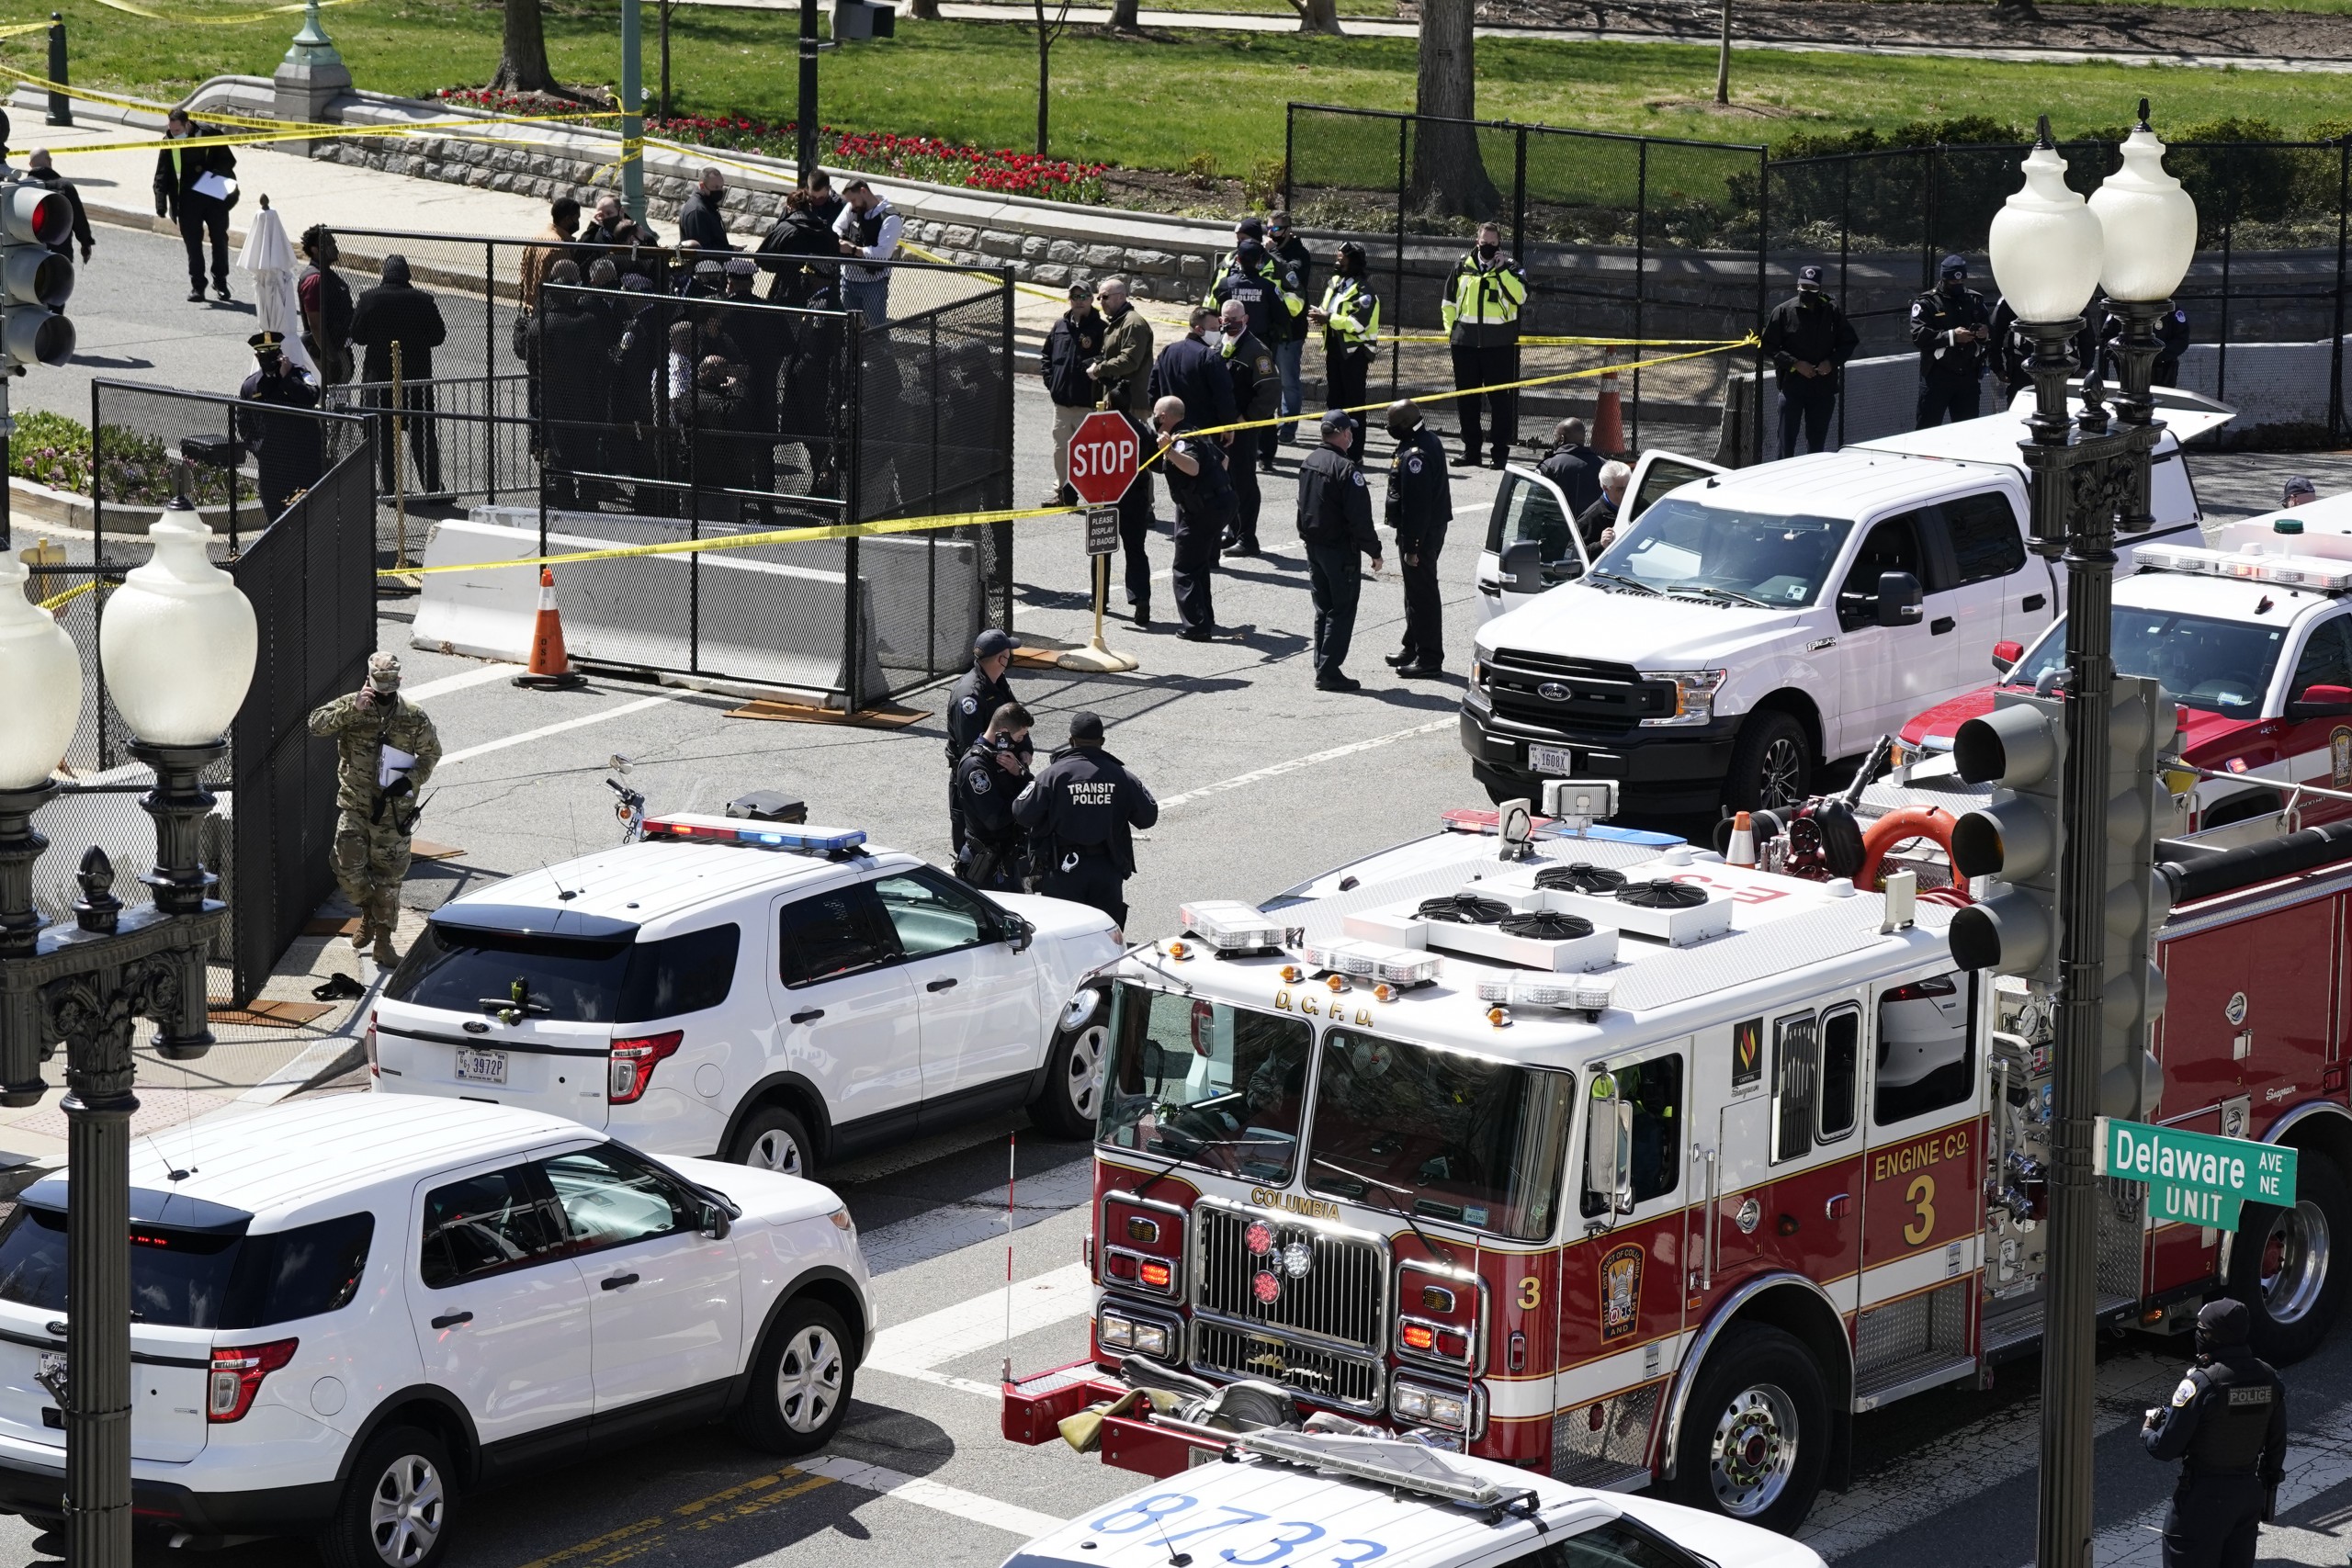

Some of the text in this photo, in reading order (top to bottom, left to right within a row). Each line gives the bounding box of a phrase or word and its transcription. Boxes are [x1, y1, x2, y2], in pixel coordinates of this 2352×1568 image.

[1073, 440, 1134, 478] STOP
[1091, 515, 1114, 525] PLEASE
[1091, 526, 1114, 536] DISPLAY
[1090, 536, 1116, 547] ID BADGE
[1544, 687, 1563, 698] Ford
[1542, 753, 1566, 769] 1608X
[1068, 783, 1115, 794] TRANSIT
[1072, 794, 1112, 805] POLICE
[1274, 989, 1374, 1027] D. C. F. D.
[473, 1057, 503, 1076] 3972P
[2236, 1076, 2242, 1086] 3
[1875, 1139, 1939, 1181] ENGINE
[2116, 1129, 2283, 1189] Delaware AVE
[2259, 1175, 2279, 1196] NE
[1251, 1187, 1340, 1223] COLUMBIA
[1904, 1174, 1936, 1247] 3
[2165, 1186, 2222, 1222] UNIT
[1756, 1243, 1760, 1253] 1
[1602, 1248, 1642, 1290] DISTRICT OF COLUMBIA
[2206, 1261, 2211, 1270] 2
[1517, 1276, 1541, 1310] 3
[1610, 1325, 1629, 1337] AND
[2230, 1390, 2272, 1403] POLICE
[1089, 1493, 1388, 1568] 8733
